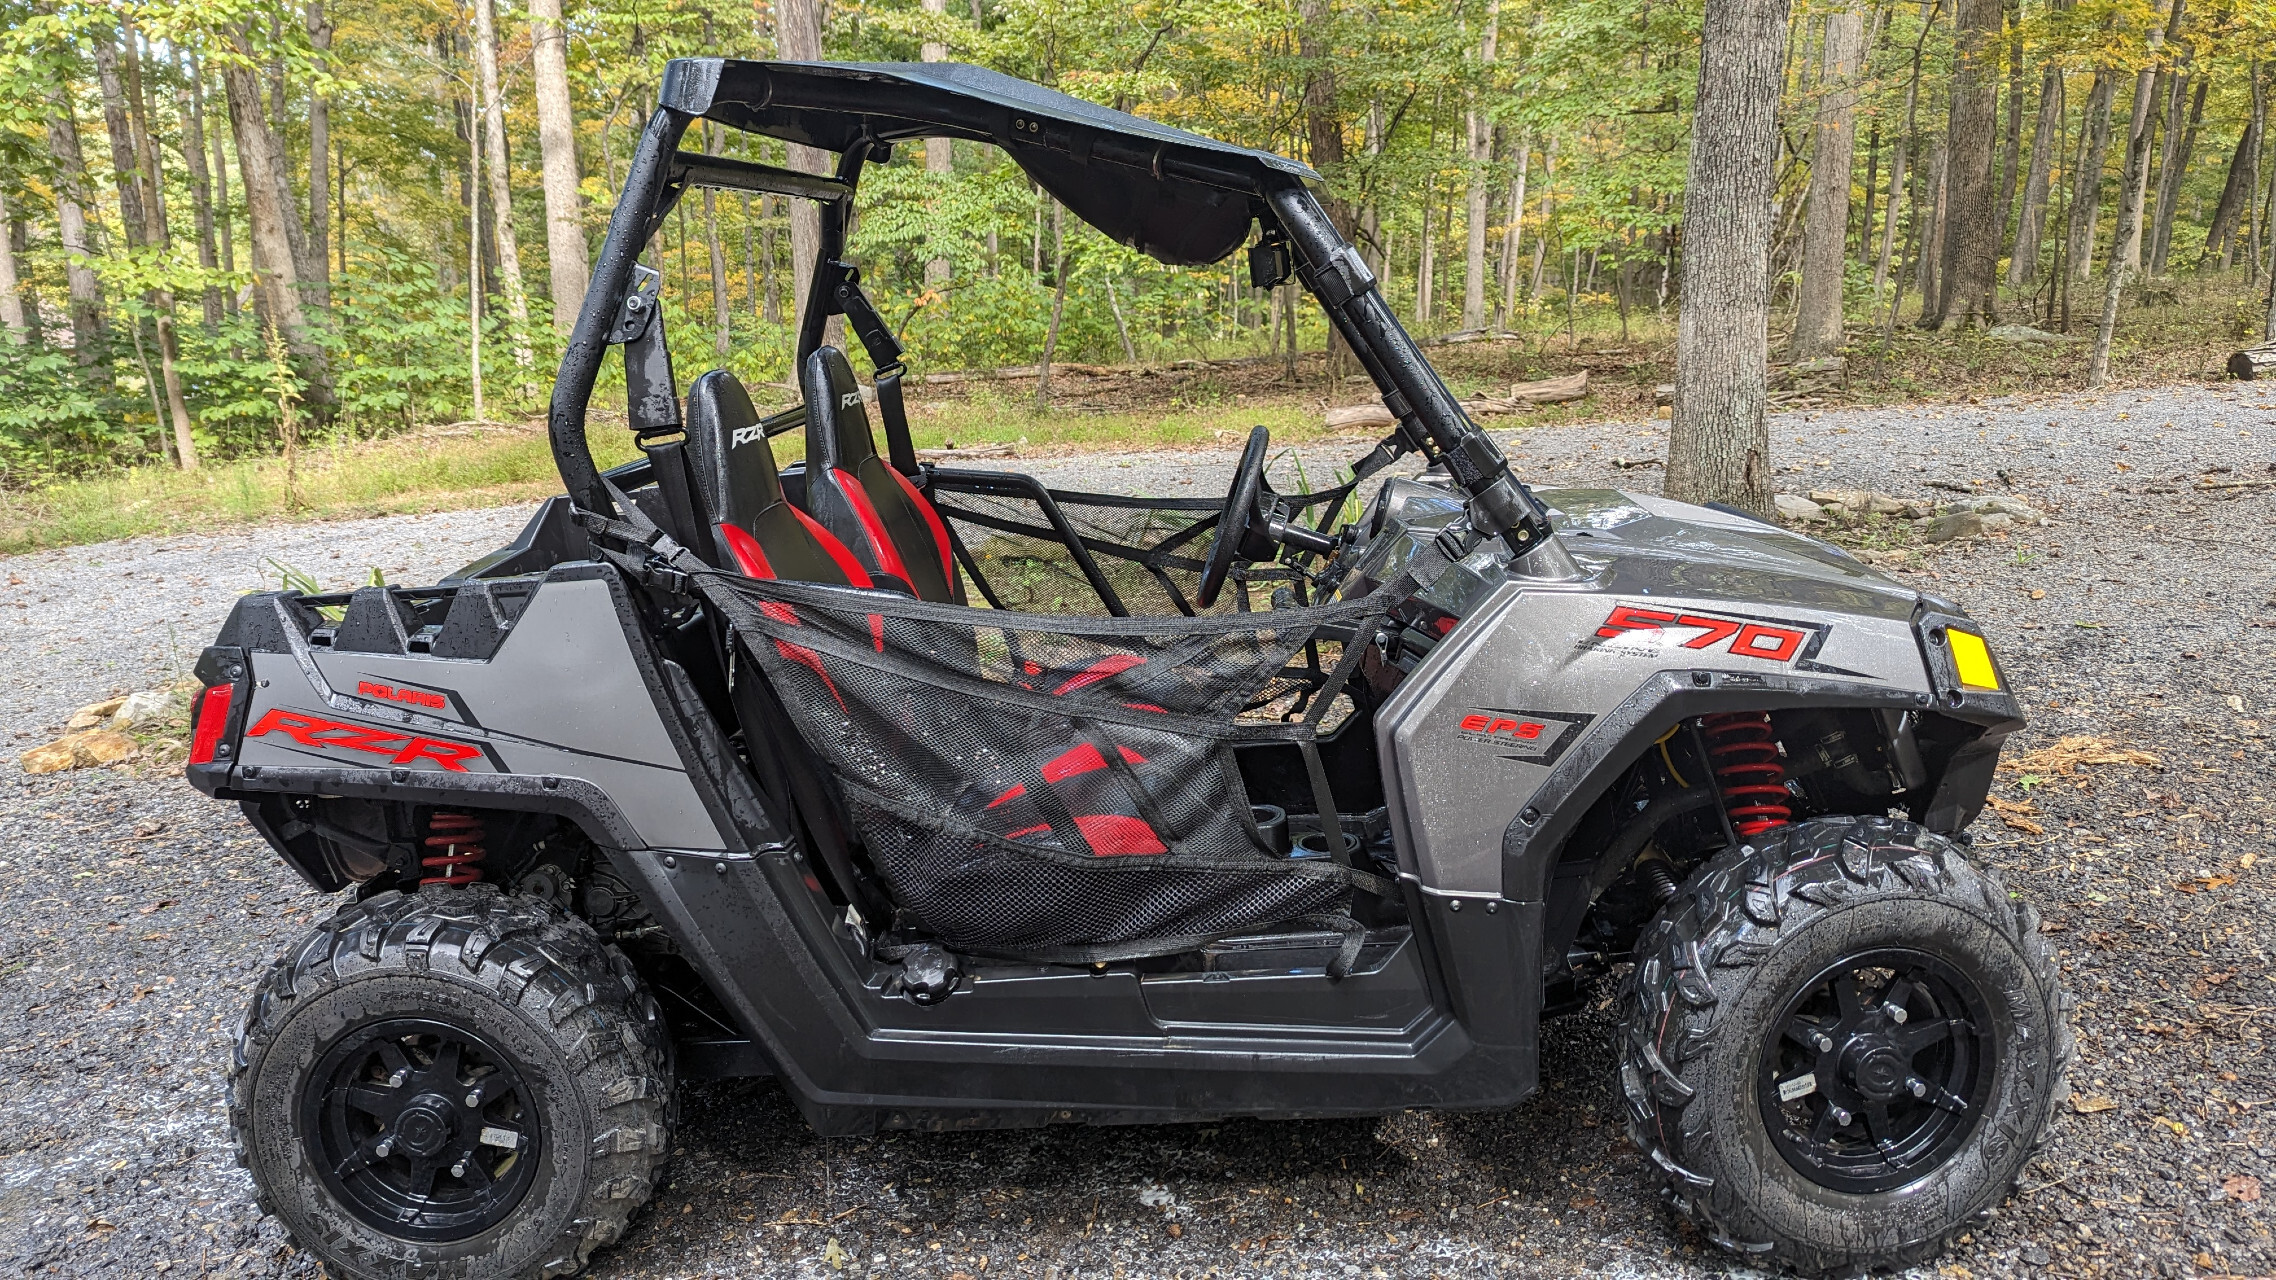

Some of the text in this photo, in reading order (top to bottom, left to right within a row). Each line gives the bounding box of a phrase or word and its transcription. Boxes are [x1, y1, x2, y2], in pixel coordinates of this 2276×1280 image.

[731, 422, 765, 450] RZR
[1594, 604, 1807, 662] 570
[358, 681, 446, 709] POLARIS
[244, 707, 484, 773] RZR
[1460, 714, 1547, 740] EPS
[1984, 988, 2038, 1164] MAXXIS
